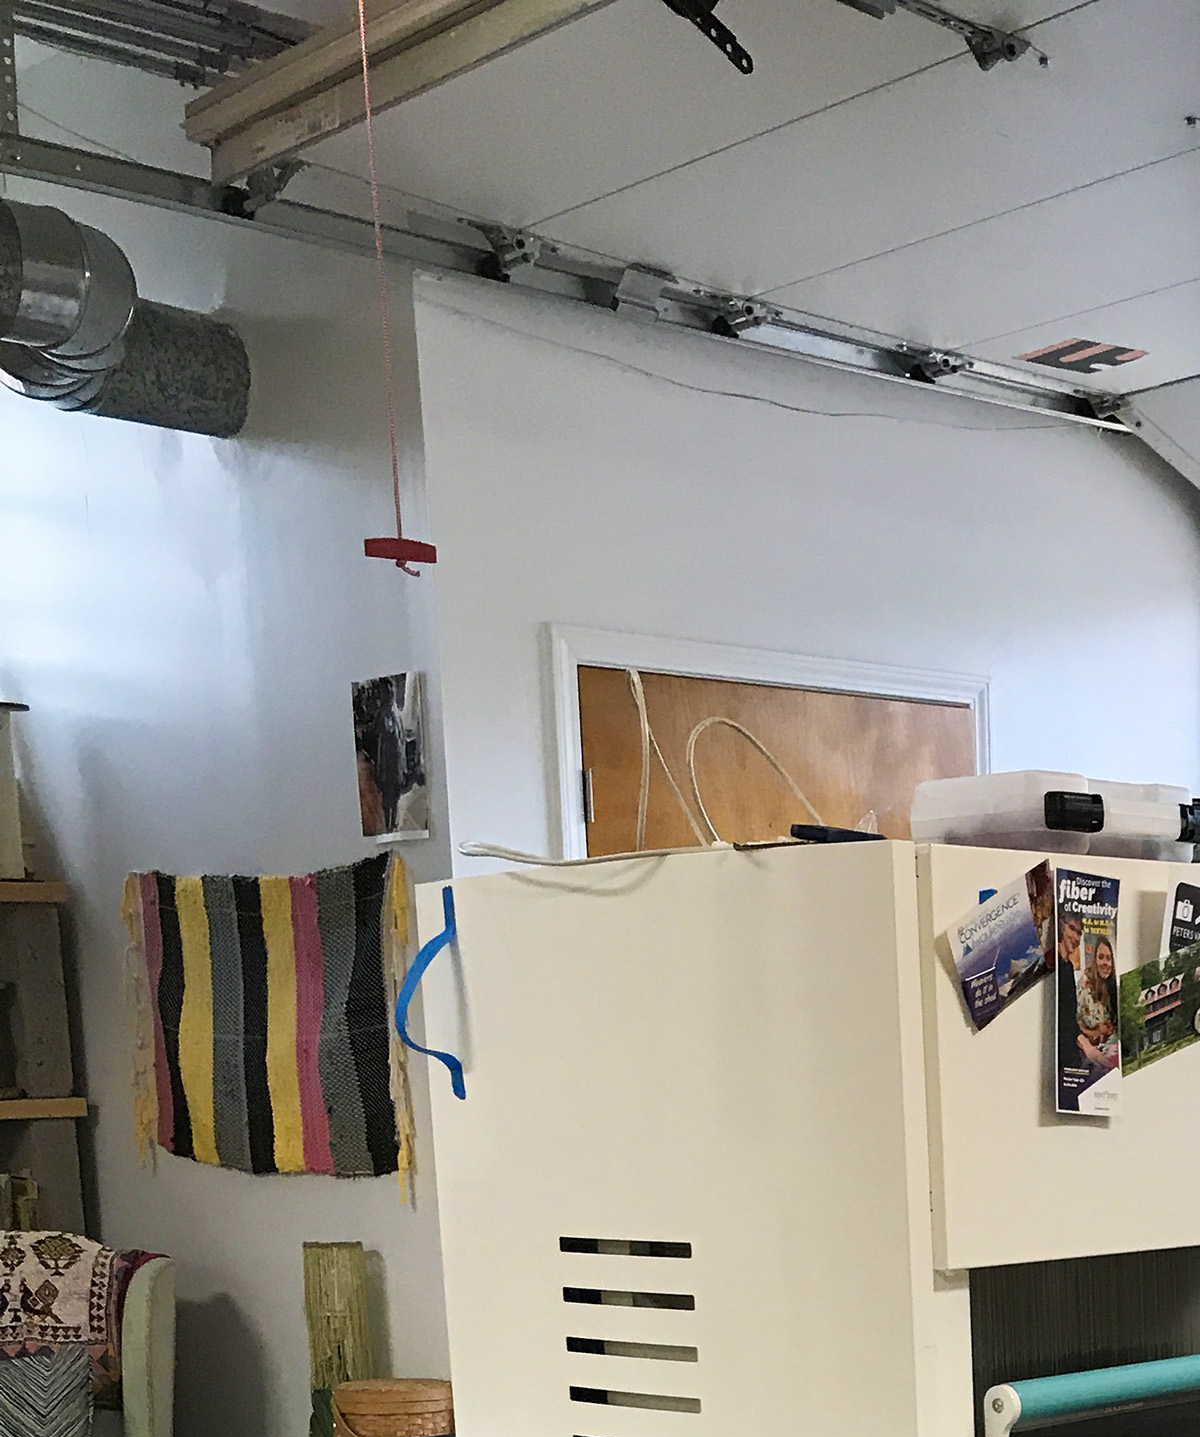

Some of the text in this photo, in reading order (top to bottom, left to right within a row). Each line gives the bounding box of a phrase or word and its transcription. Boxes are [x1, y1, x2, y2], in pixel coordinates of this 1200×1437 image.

[1059, 879, 1096, 903] fiber
[1076, 876, 1111, 889] Discover the
[1064, 901, 1118, 919] of Creativity
[959, 895, 1019, 944] CONVERGENCE
[1173, 926, 1194, 940] PETERS
